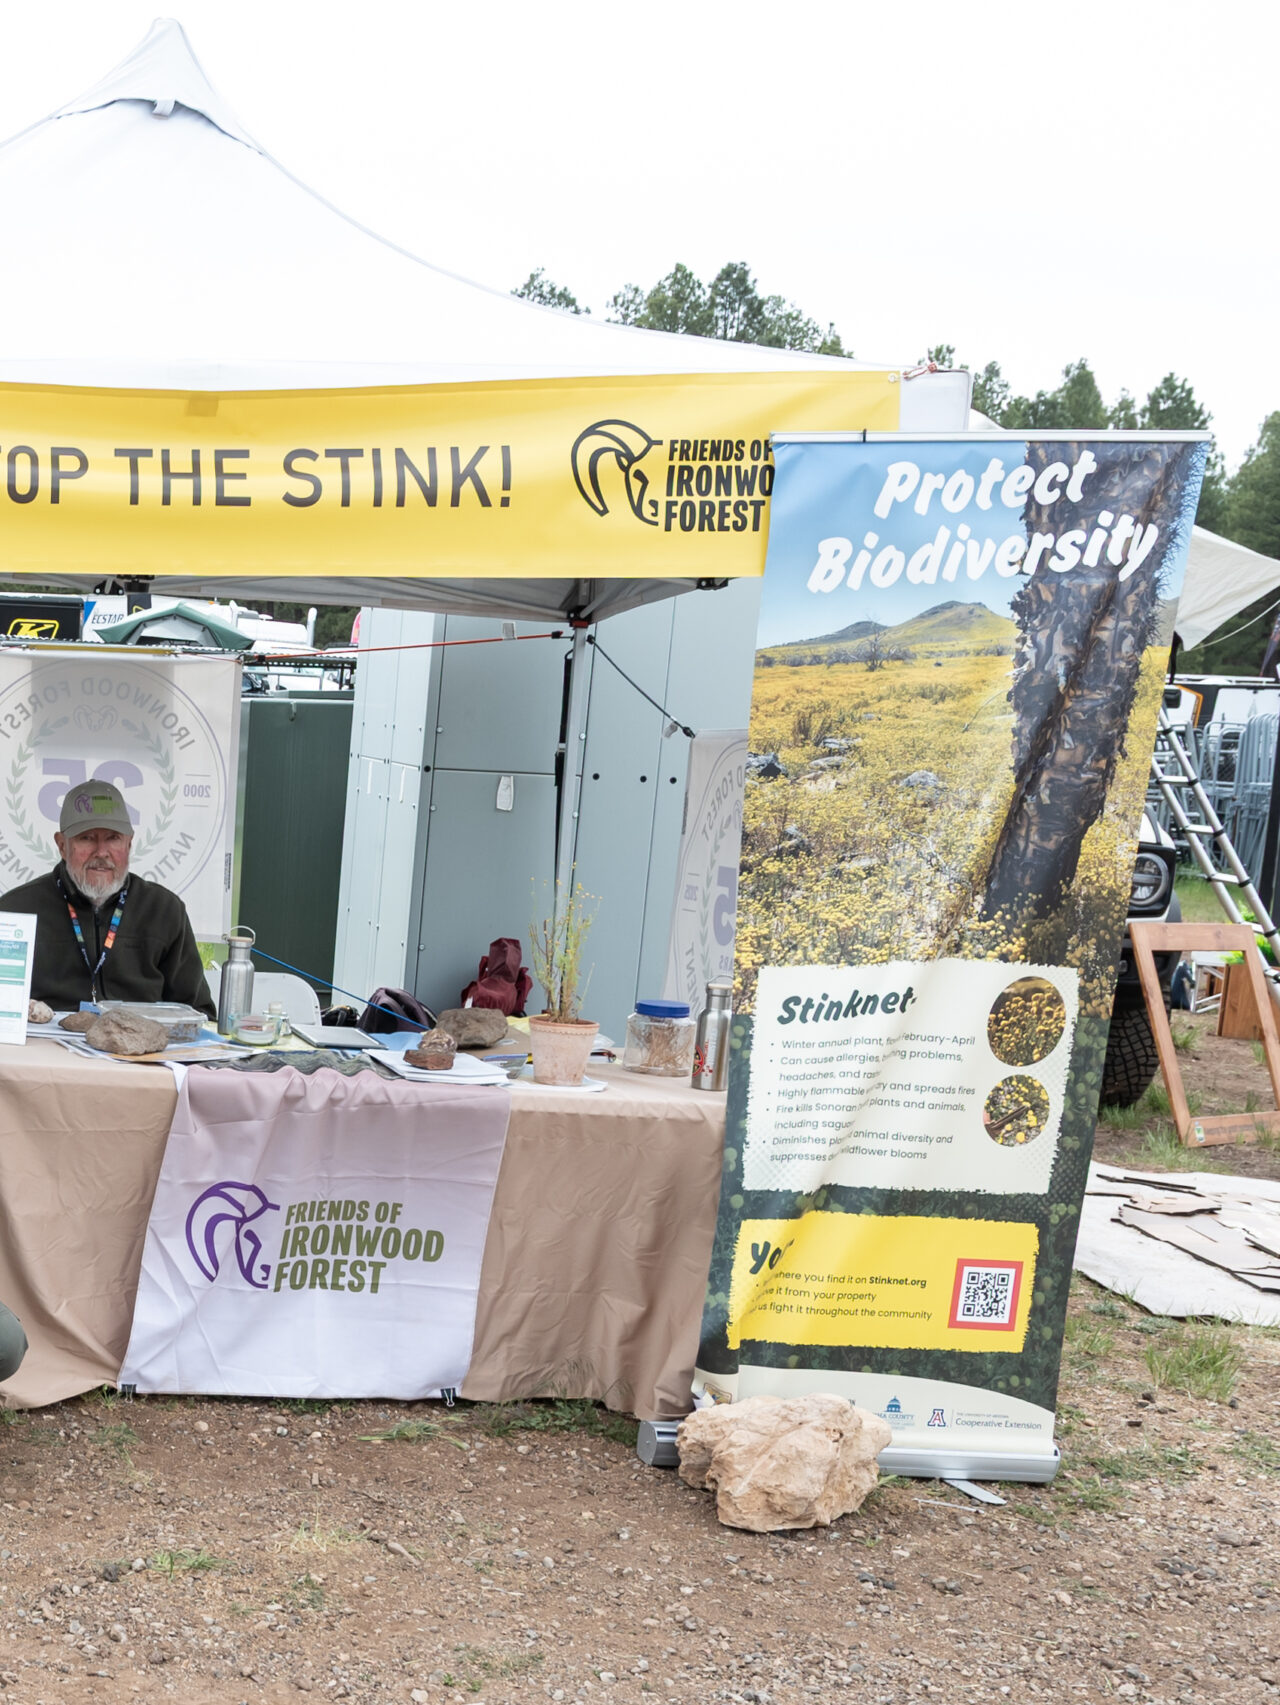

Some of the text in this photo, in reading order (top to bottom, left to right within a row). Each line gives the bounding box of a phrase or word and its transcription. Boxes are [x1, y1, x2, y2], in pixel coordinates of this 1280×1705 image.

[669, 439, 745, 461] FRIENDS
[114, 448, 251, 506] THE
[282, 445, 511, 508] STINK!
[666, 464, 775, 496] IRONWO
[873, 449, 1097, 519] Protect
[665, 500, 765, 532] FOREST
[806, 510, 1159, 593] Biodiversity
[92, 614, 124, 624] ECSTAR
[777, 986, 914, 1025] Stinknet
[782, 1040, 816, 1049] Winter
[818, 1038, 852, 1048] annual
[854, 1037, 884, 1048] plant,
[781, 1056, 802, 1065] Can
[805, 1056, 834, 1065] cause
[836, 1053, 880, 1065] allergies,
[909, 1050, 964, 1063] problems,
[780, 1070, 836, 1082] headaches,
[838, 1069, 860, 1079] and
[778, 1088, 808, 1099] Highly
[810, 1086, 865, 1096] flammable
[890, 1082, 912, 1092] and
[914, 1084, 956, 1095] spreads
[958, 1086, 976, 1096] fires
[776, 1104, 794, 1113] Fire
[796, 1103, 812, 1112] kills
[815, 1102, 857, 1112] Sonoran
[903, 1099, 925, 1108] and
[928, 1102, 967, 1112] animals,
[774, 1119, 818, 1130] including
[772, 1136, 826, 1146] Diminishes
[854, 1130, 888, 1140] animal
[892, 1132, 934, 1146] diversity
[936, 1134, 953, 1144] and
[770, 1152, 827, 1163] suppresses
[890, 1149, 928, 1160] blooms
[285, 1200, 403, 1226] FRIENDS OF
[279, 1224, 444, 1263] IRONWOOD
[273, 1259, 387, 1294] FOREST
[804, 1274, 824, 1284] you
[827, 1274, 846, 1284] find
[848, 1276, 854, 1284] it
[869, 1276, 927, 1288] Stinknet.org
[776, 1286, 876, 1302] it from your property
[770, 1302, 794, 1314] fight
[796, 1304, 804, 1313] it
[806, 1306, 858, 1318] throughout
[861, 1308, 876, 1317] the
[878, 1309, 932, 1320] community
[956, 1418, 1042, 1430] Cooperative Extension
